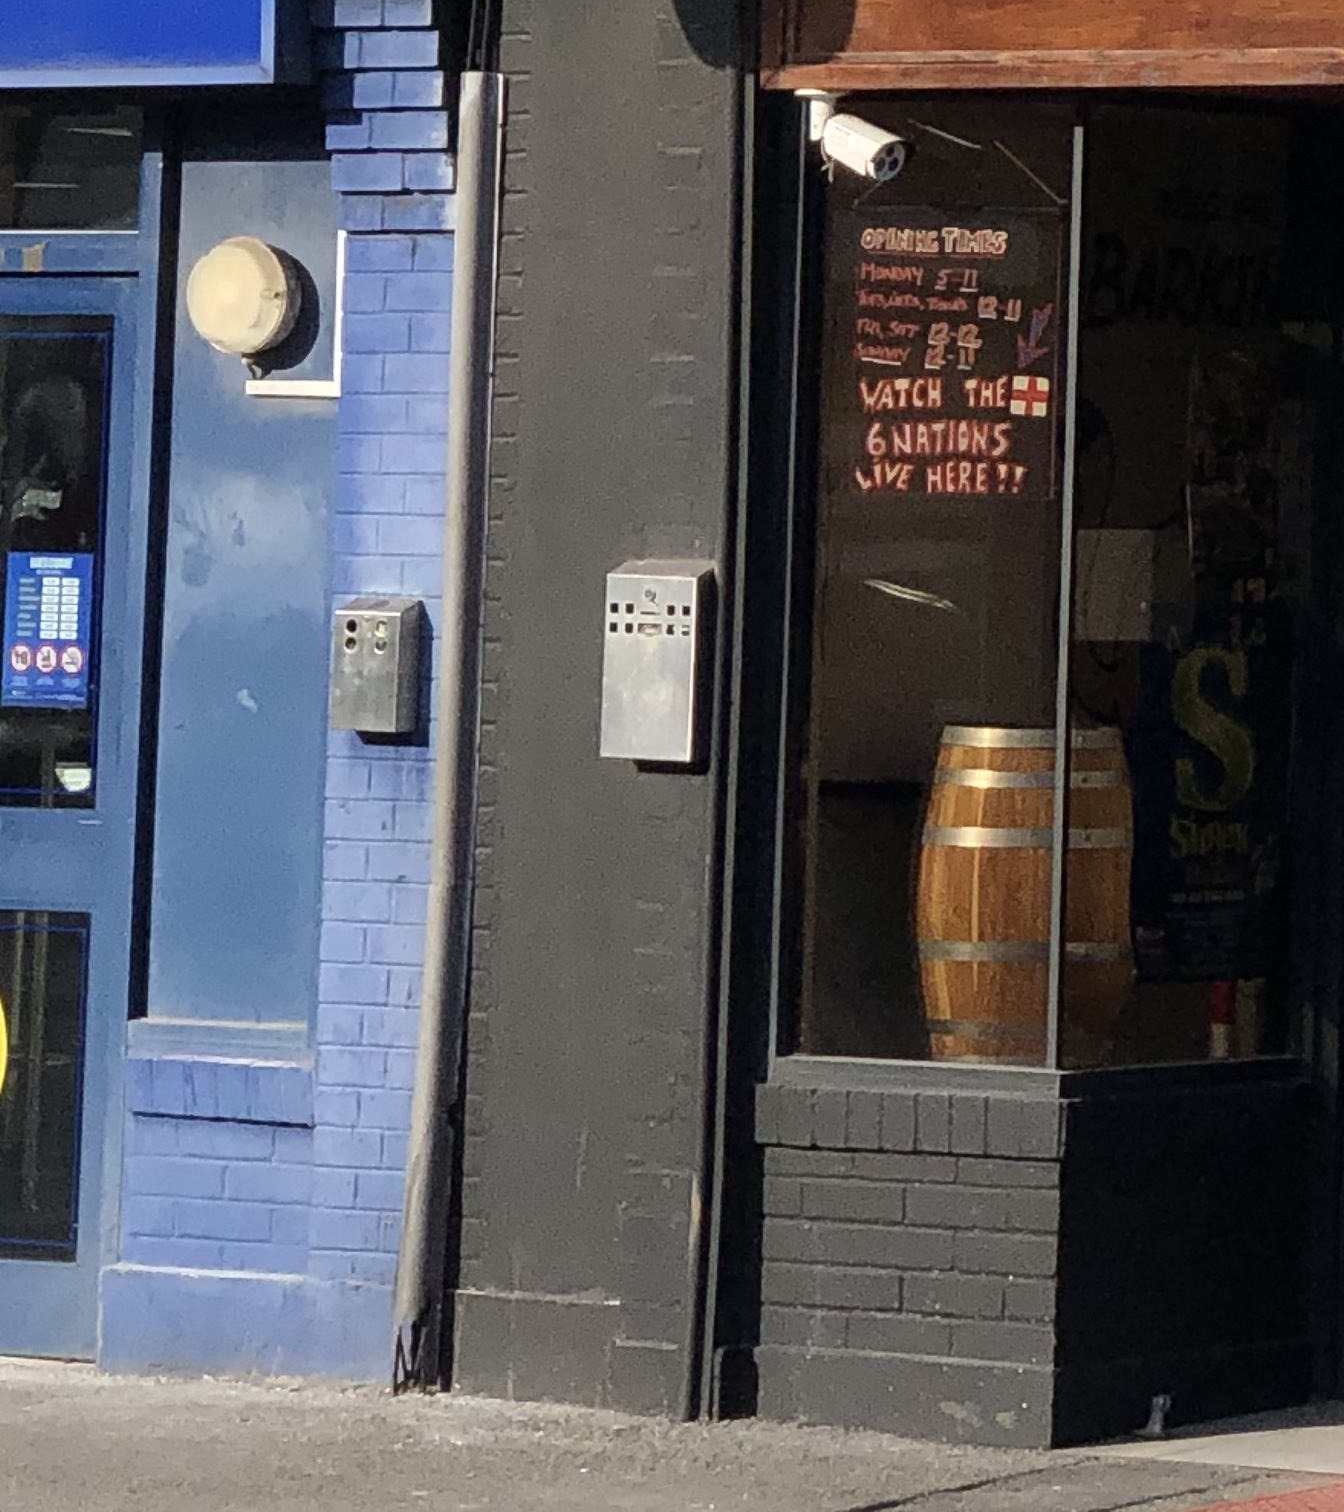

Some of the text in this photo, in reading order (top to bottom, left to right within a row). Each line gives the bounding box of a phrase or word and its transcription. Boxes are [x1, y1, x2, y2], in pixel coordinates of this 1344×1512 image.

[941, 226, 1009, 255] TIMES
[859, 262, 923, 286] MONDAY
[860, 375, 1008, 413] WATCH THE
[867, 420, 1012, 456] 6 NATIONS
[855, 458, 914, 491] LIVE
